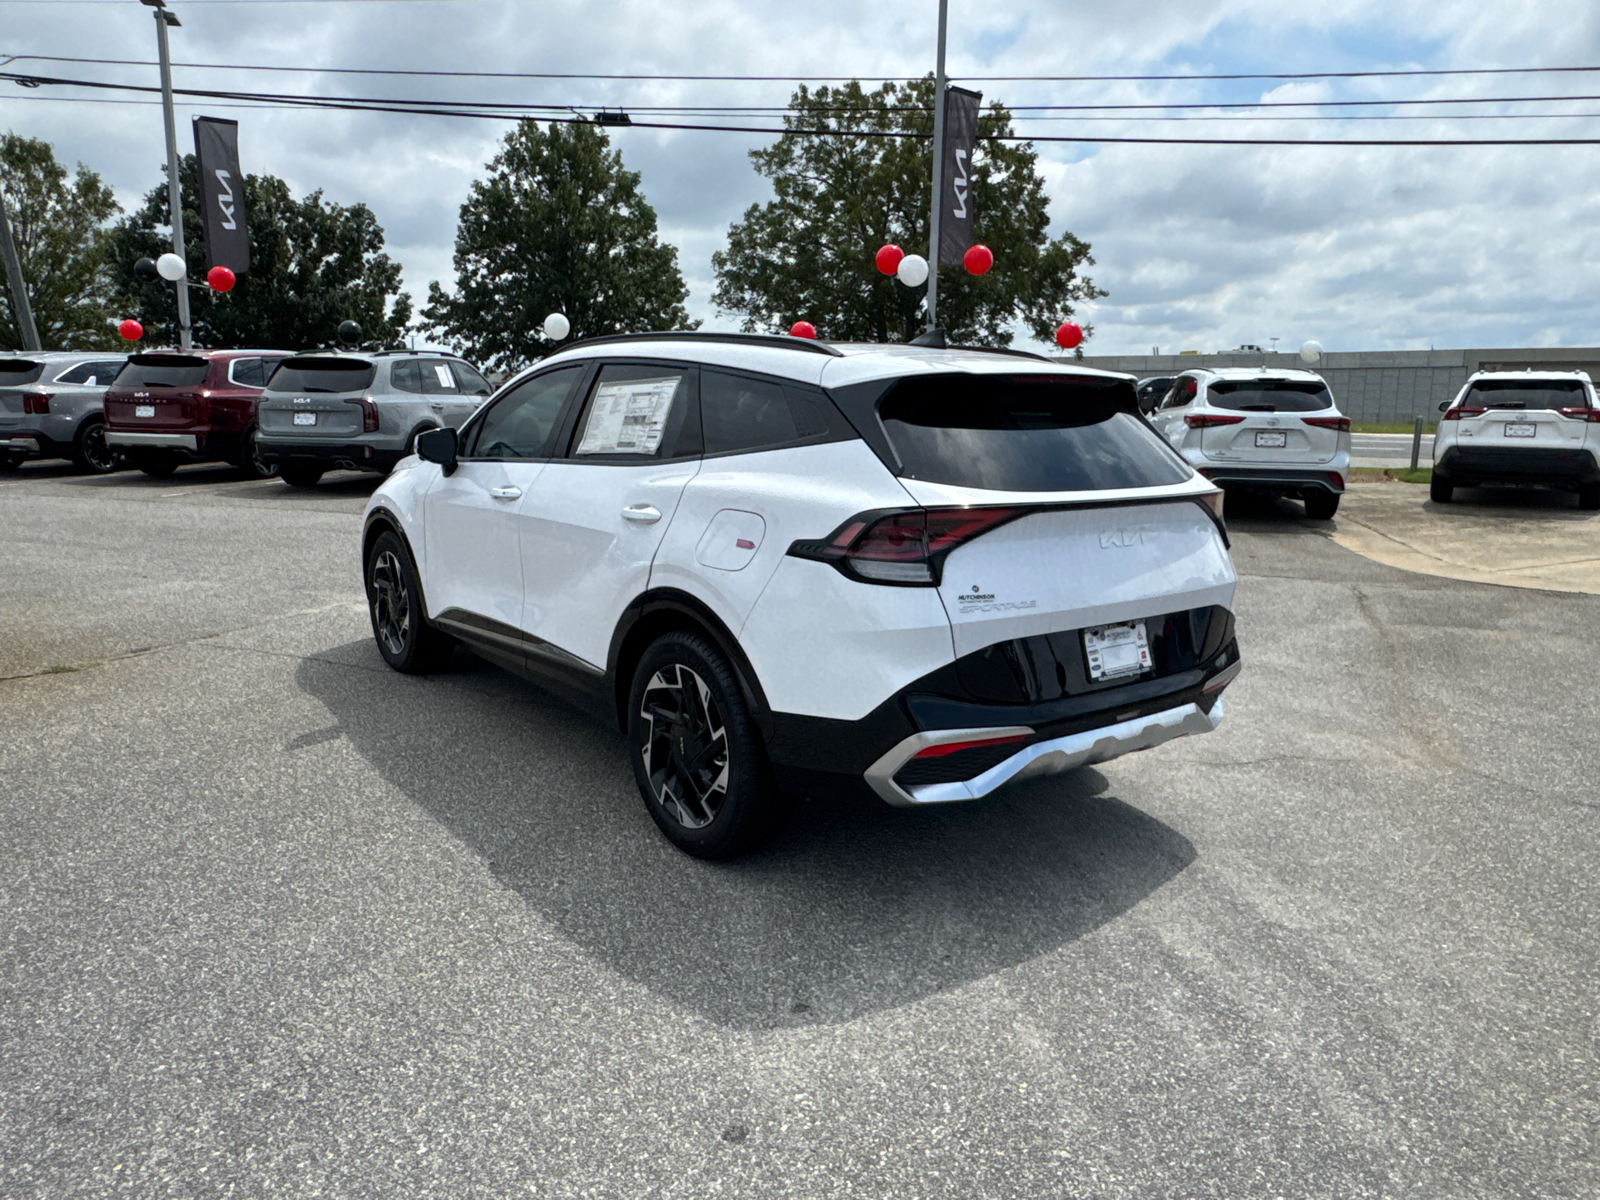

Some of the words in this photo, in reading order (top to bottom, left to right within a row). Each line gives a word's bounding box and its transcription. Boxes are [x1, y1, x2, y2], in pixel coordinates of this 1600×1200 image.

[215, 169, 237, 230] KIA
[953, 148, 968, 219] KIA
[1098, 527, 1146, 549] KIA
